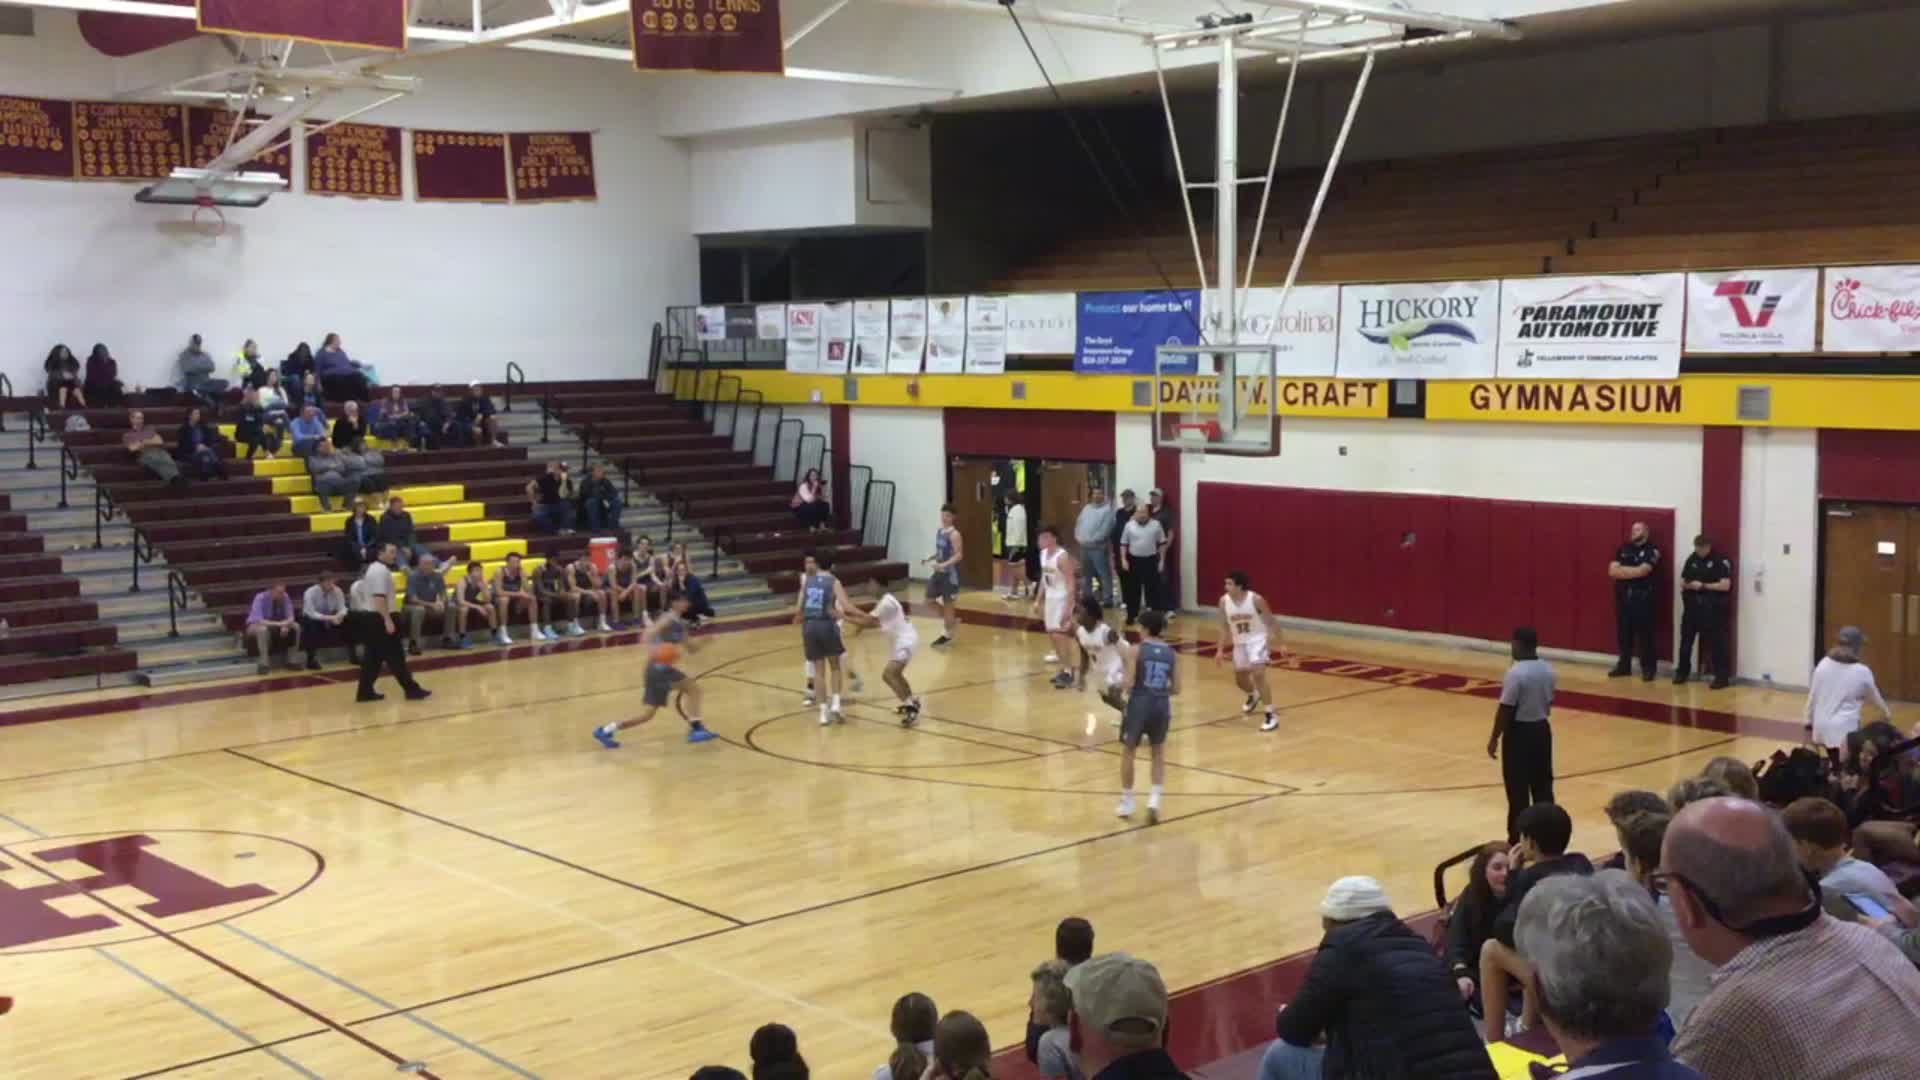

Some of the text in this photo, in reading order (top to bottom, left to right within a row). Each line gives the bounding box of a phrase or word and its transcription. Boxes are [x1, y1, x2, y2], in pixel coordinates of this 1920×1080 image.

[1121, 304, 1137, 313] our
[1139, 302, 1167, 313] home
[1360, 296, 1479, 328] HICKORY
[1519, 303, 1662, 321] PARAMOUNT
[1516, 320, 1660, 338] AUTOMOTIVE
[1282, 382, 1379, 408] CRAFT
[1470, 384, 1682, 413] GYMNASIUM
